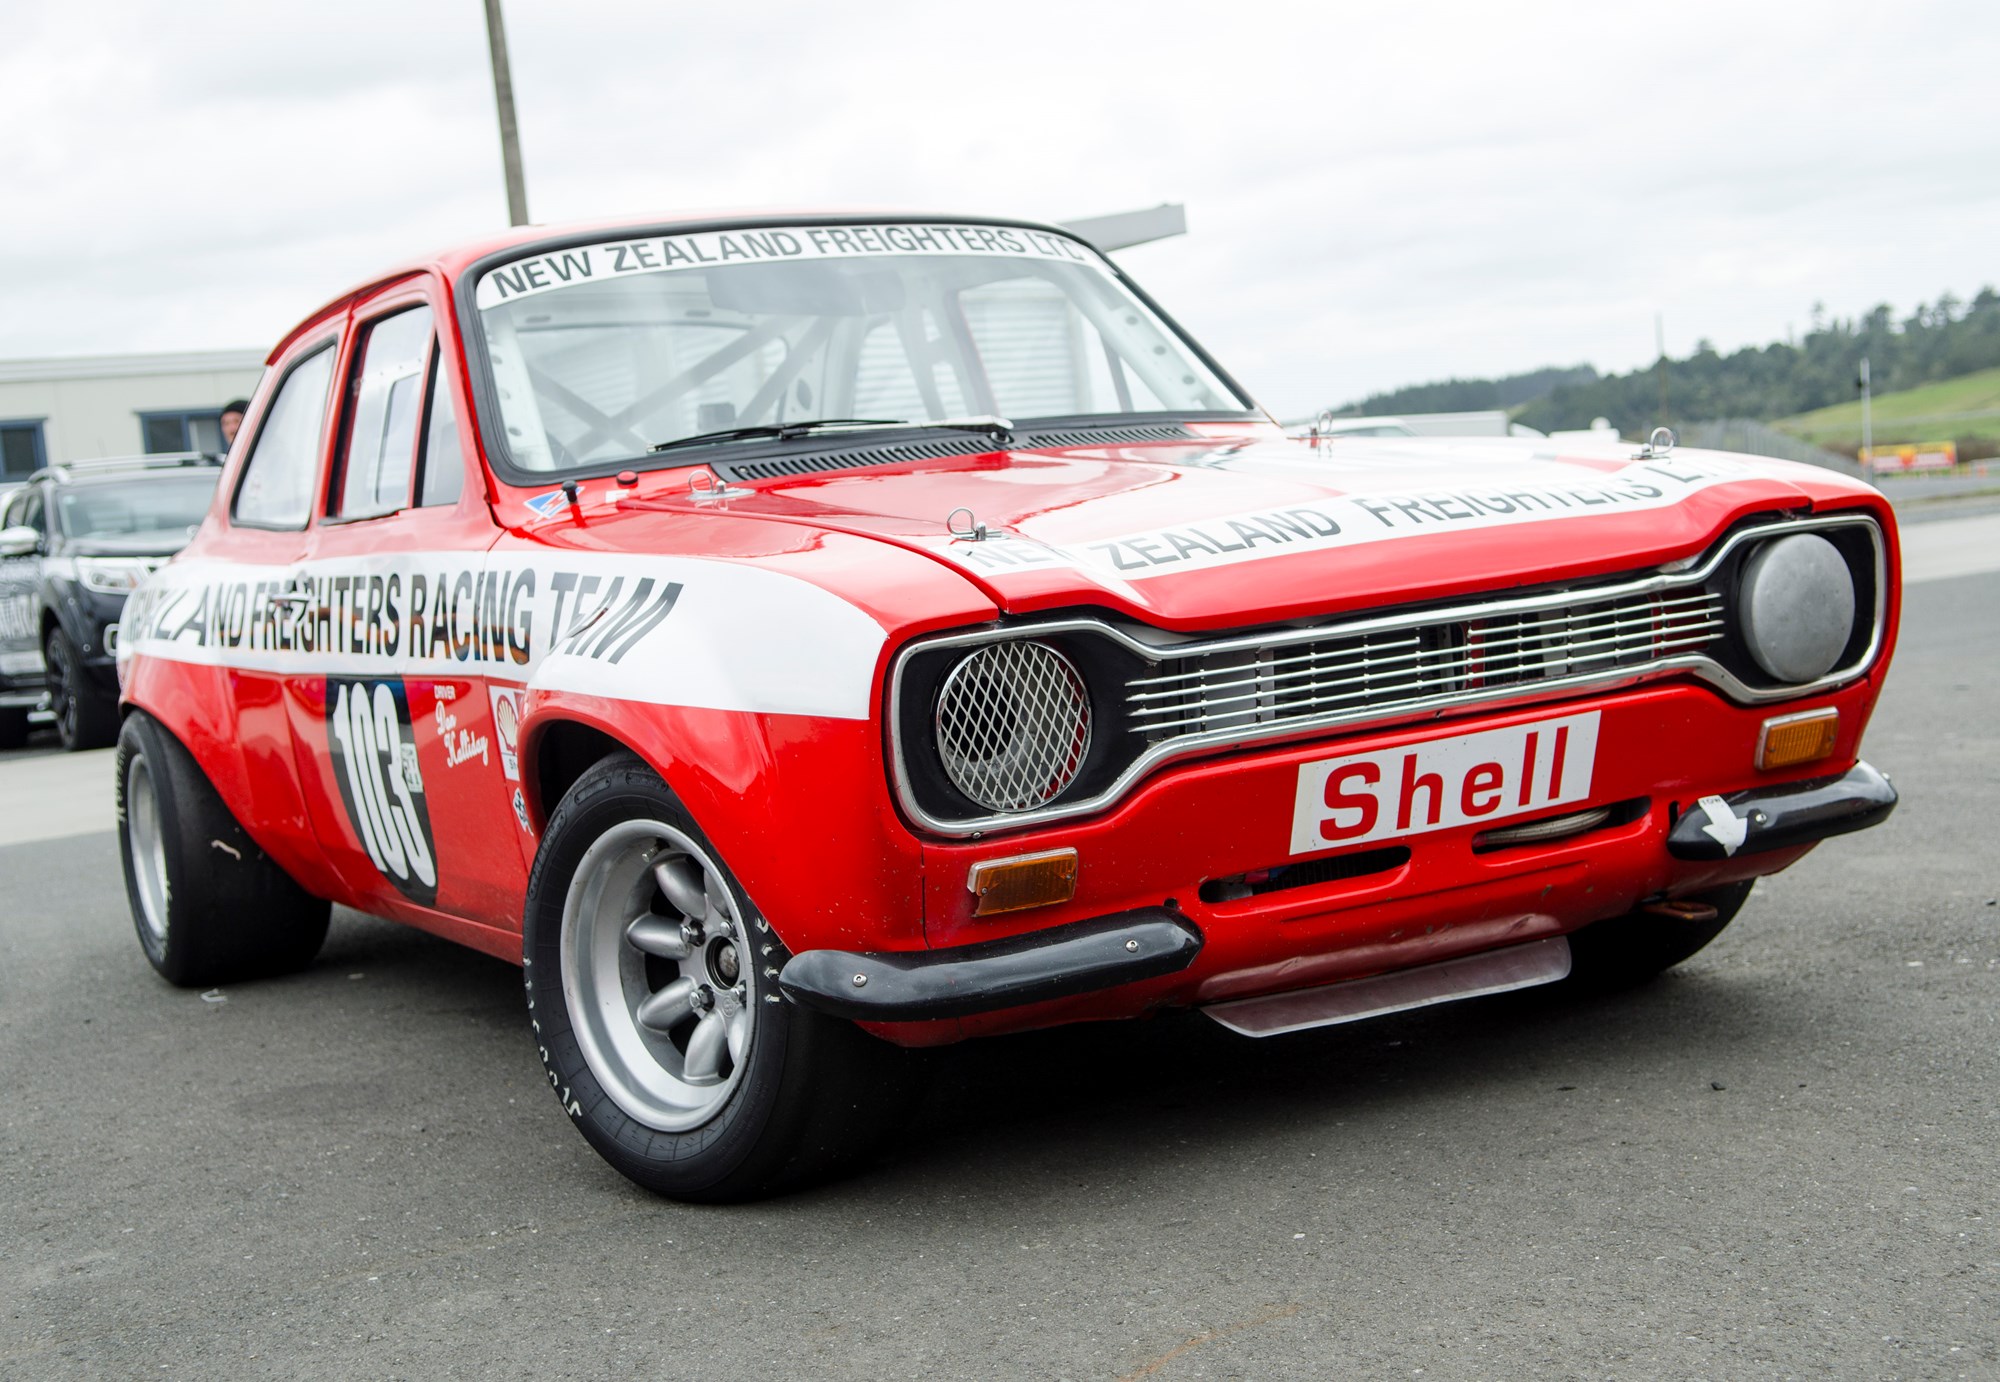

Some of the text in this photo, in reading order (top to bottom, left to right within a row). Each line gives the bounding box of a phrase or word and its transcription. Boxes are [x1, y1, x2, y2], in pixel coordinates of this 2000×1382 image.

[492, 250, 592, 298] NEW
[604, 231, 802, 272] ZEALAND
[806, 226, 1026, 254] FREIGHTERS
[1087, 508, 1342, 571] ZEALAND
[1348, 478, 1664, 528] FREIGHTERS
[409, 568, 536, 665] RACING
[549, 571, 685, 665] TEAM
[332, 682, 437, 888] 103
[1319, 725, 1570, 841] Shell
